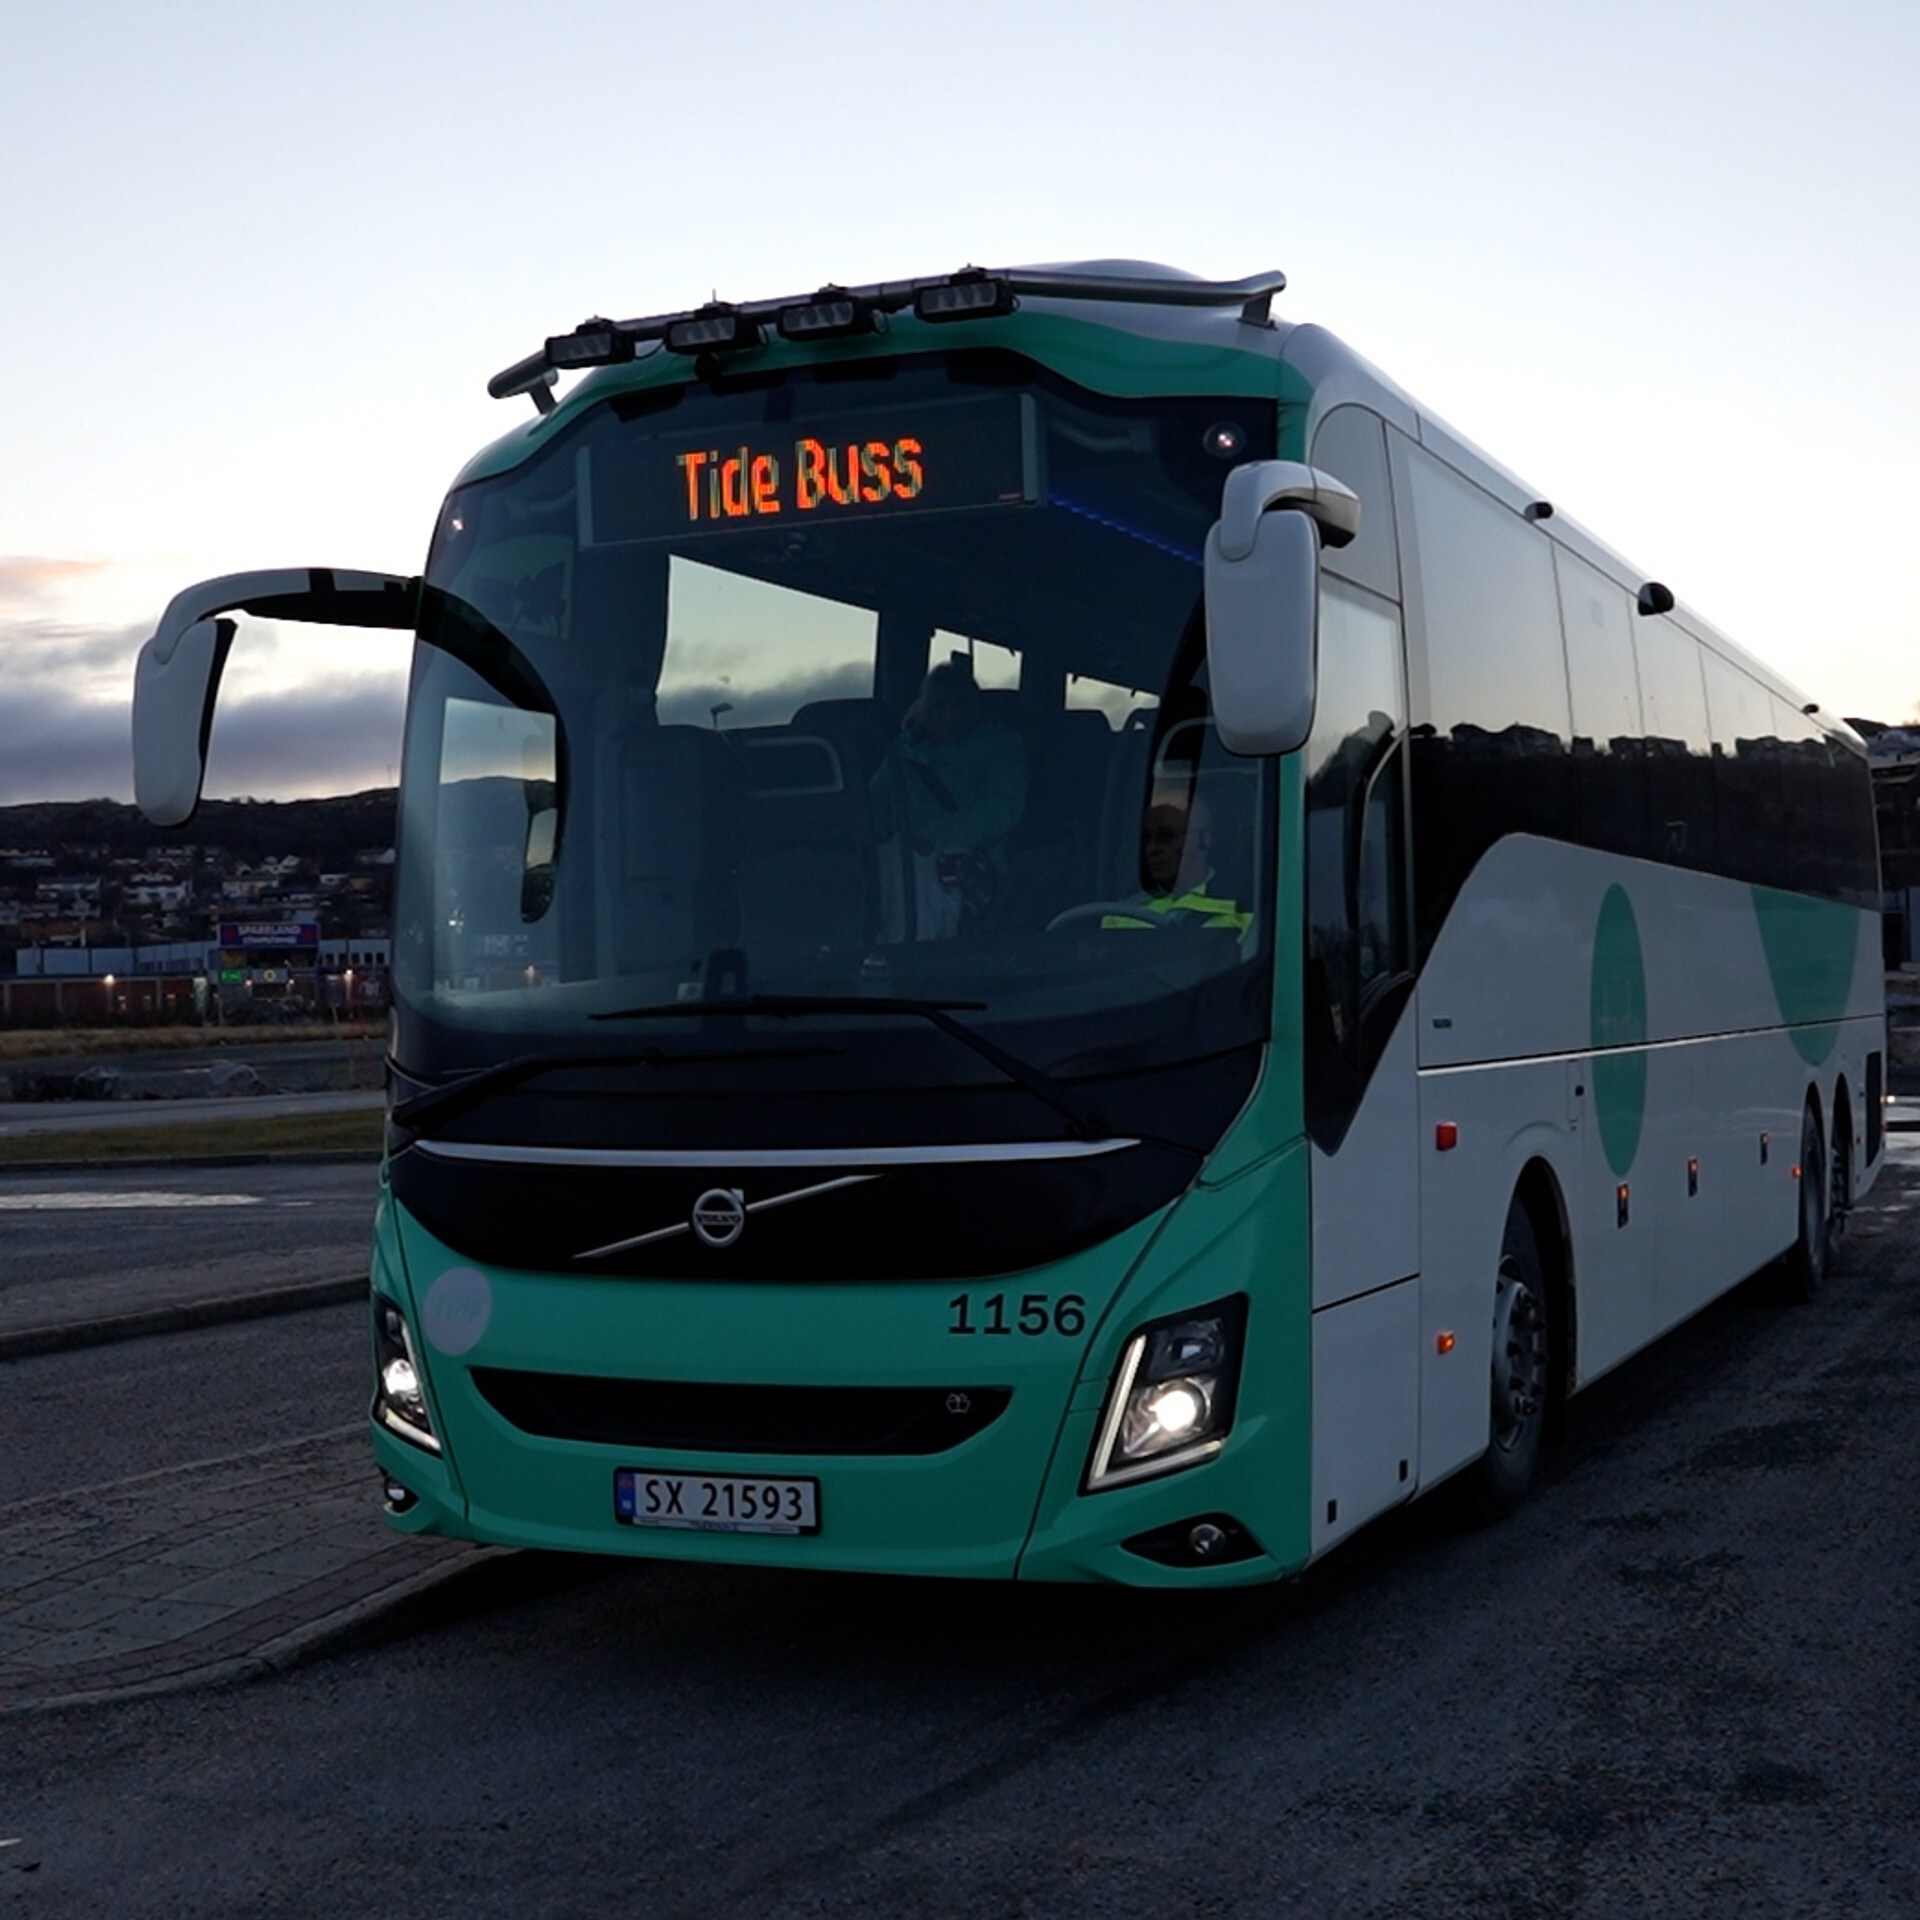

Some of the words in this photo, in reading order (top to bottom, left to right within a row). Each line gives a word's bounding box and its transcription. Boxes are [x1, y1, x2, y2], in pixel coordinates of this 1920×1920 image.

[676, 446, 781, 521] Tide
[796, 438, 923, 509] Buss
[948, 1292, 1086, 1336] 1156
[645, 1479, 684, 1515] SX
[701, 1482, 802, 1521] 21593
